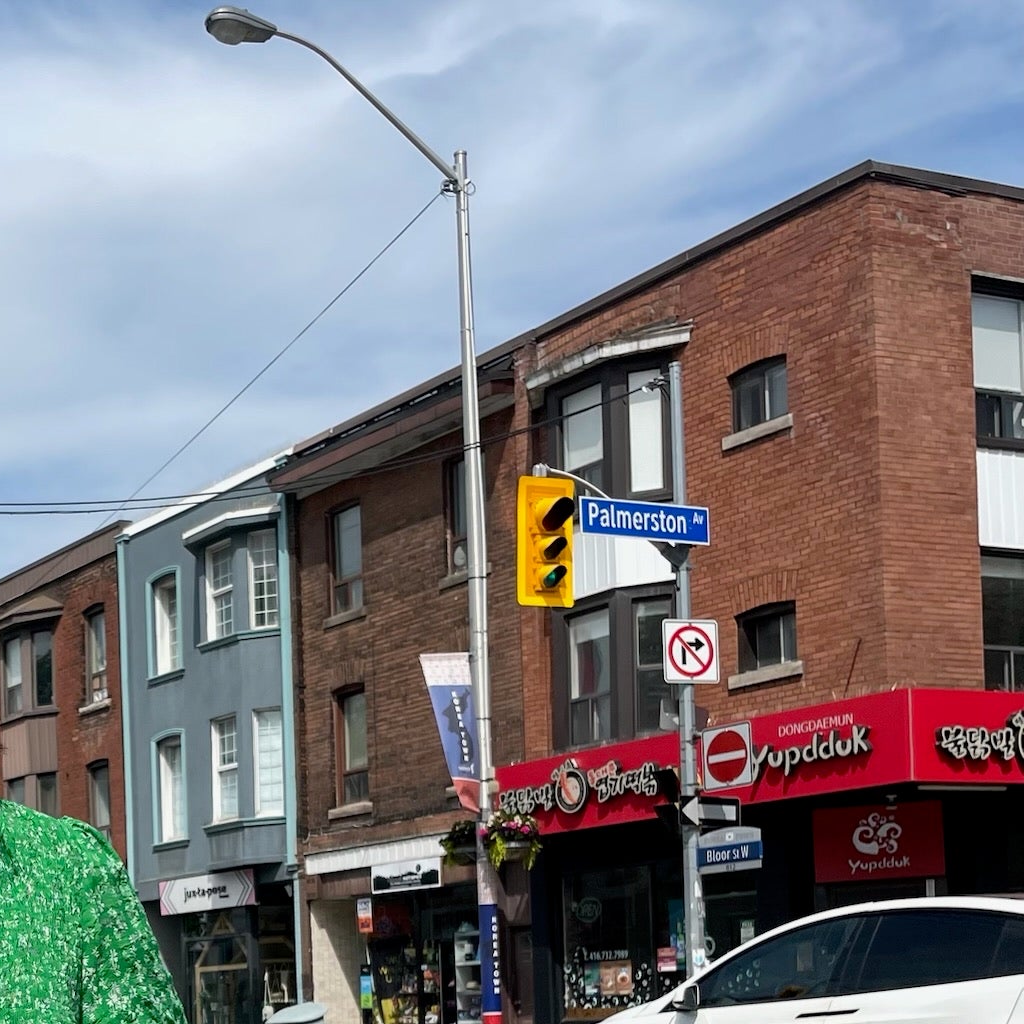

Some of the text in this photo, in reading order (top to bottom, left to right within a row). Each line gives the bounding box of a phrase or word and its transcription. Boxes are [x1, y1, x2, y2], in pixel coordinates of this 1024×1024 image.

[588, 502, 704, 535] Palmerston Av
[451, 691, 464, 728] KOREA
[461, 731, 469, 762] TOWN
[778, 713, 854, 738] DONGDAEMUN
[595, 762, 659, 803] 엽기떡볶
[706, 849, 731, 863] Bloor
[740, 844, 749, 859] W
[848, 856, 910, 875] Yupdduk
